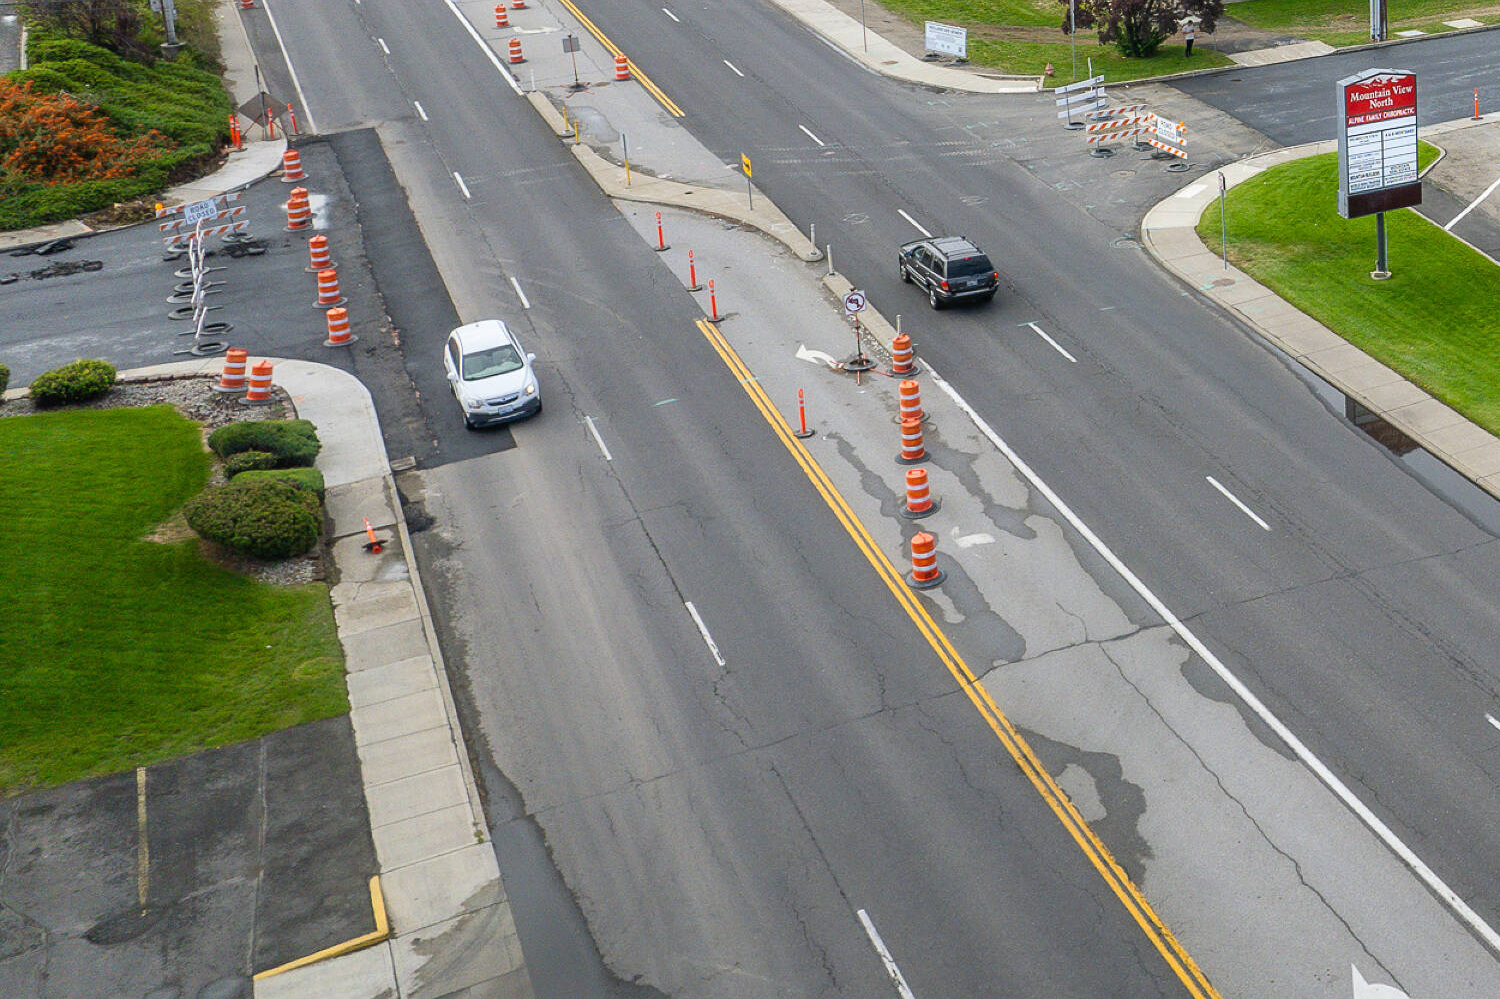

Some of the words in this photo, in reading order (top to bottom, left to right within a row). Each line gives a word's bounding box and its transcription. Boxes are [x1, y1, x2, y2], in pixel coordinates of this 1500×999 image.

[1350, 88, 1391, 102] Mountain
[1392, 85, 1413, 95] View
[1369, 97, 1394, 110] North
[190, 202, 209, 213] ROAD
[191, 207, 215, 221] CLOSED
